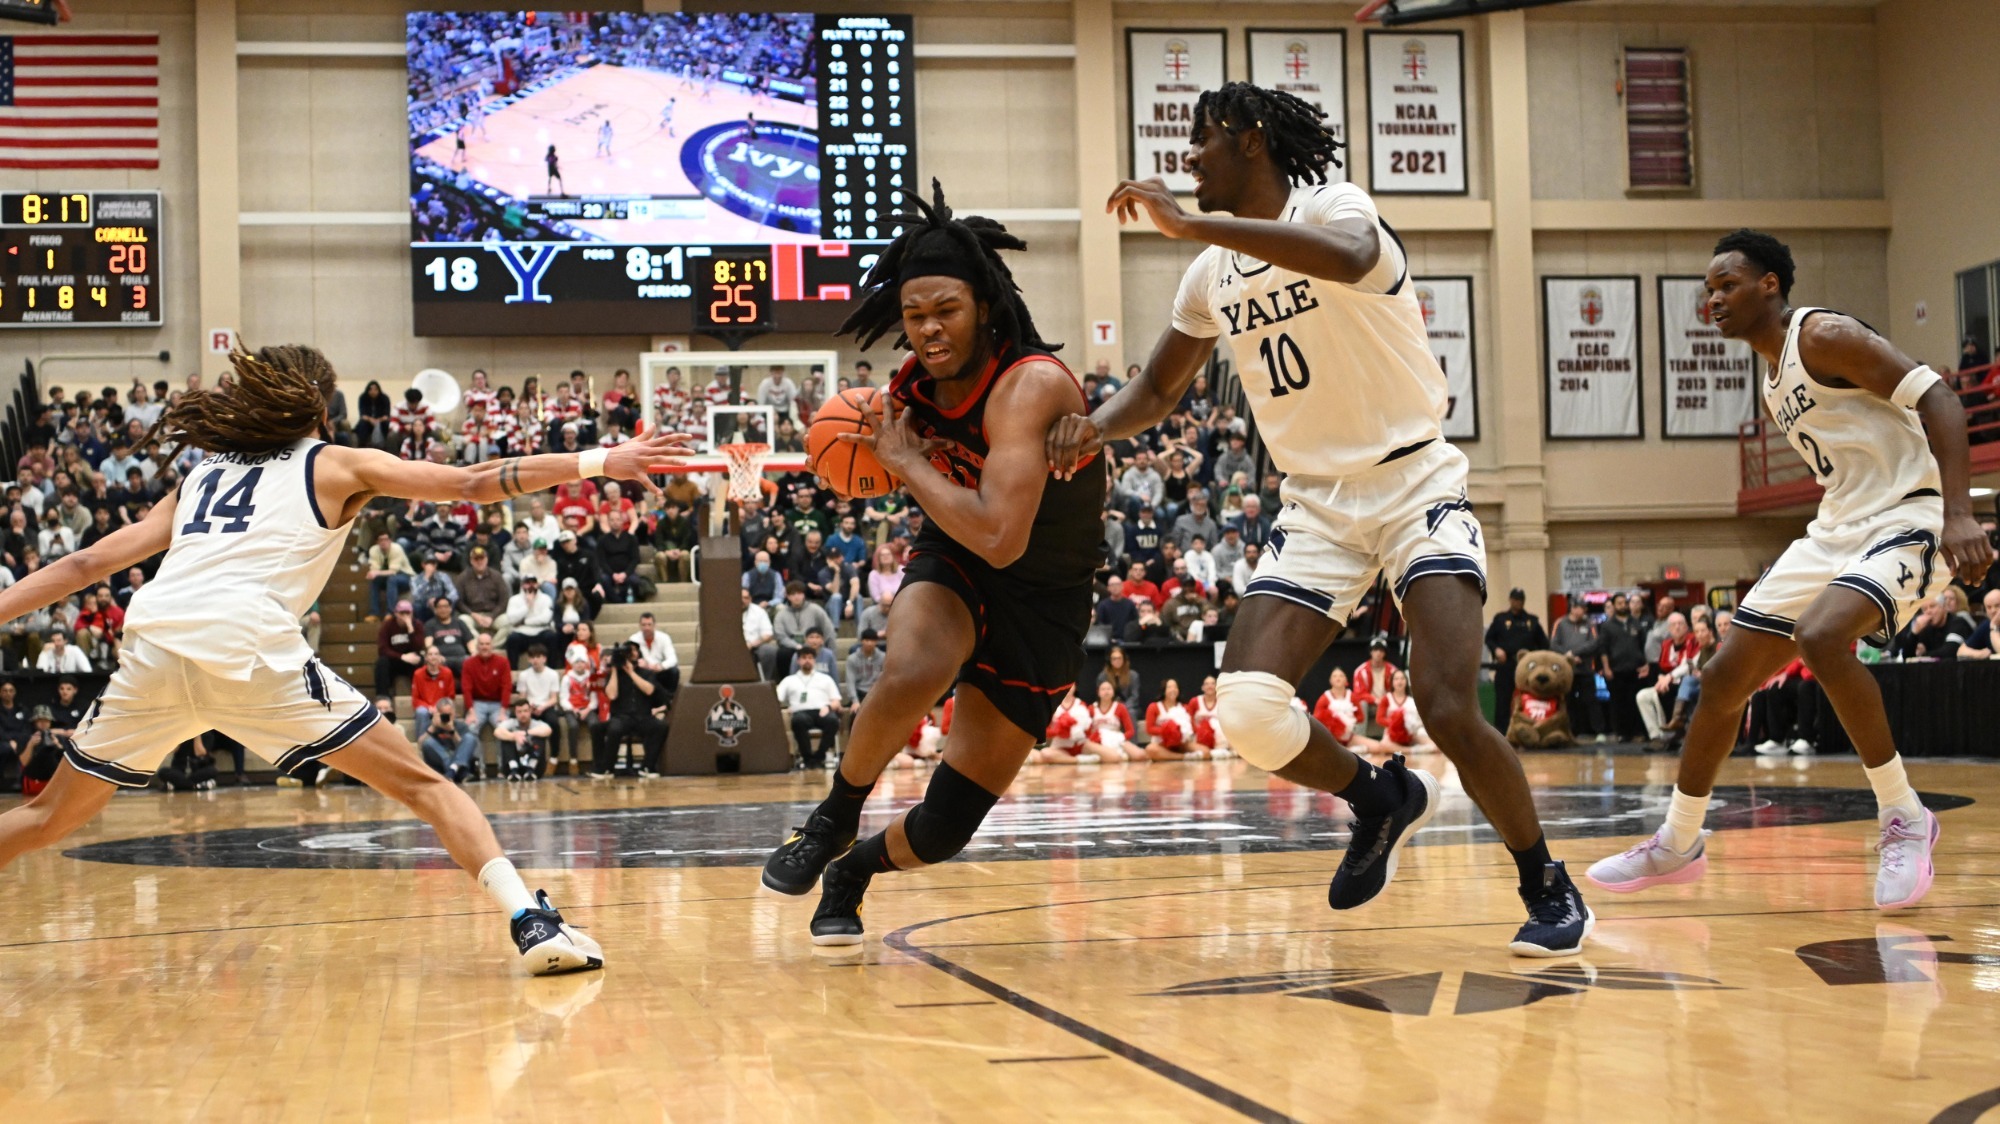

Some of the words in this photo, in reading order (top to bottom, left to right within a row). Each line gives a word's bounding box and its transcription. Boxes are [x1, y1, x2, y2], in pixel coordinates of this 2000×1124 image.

[862, 61, 872, 75] 1
[889, 95, 900, 109] 7
[889, 113, 901, 126] 2
[1153, 103, 1191, 121] NCA
[1396, 104, 1437, 120] NCAA
[1138, 125, 1192, 138] TOURNA
[1378, 123, 1456, 136] TOURNAMENT
[1153, 151, 1193, 174] 199
[1391, 150, 1446, 174] 2021
[866, 173, 876, 187] 1
[23, 194, 87, 224] 8:17
[29, 235, 63, 246] PERIOD
[95, 227, 148, 242] CORNELL
[46, 249, 54, 270] 1
[109, 244, 146, 273] 20
[17, 275, 40, 285] FOUL
[42, 275, 75, 285] PLAYER
[120, 275, 150, 285] FOULS
[425, 257, 479, 291] 18
[483, 244, 571, 304] Y
[714, 260, 767, 284] 8:17
[91, 287, 107, 307] 4
[132, 285, 146, 309] 3
[638, 285, 692, 298] PERIOD
[711, 284, 757, 323] 25
[1221, 279, 1319, 336] YALE
[22, 311, 74, 322] ADVANTAGE
[121, 311, 150, 322] SCORE
[213, 332, 229, 350] R
[1096, 324, 1111, 341] T
[1685, 330, 1722, 339] GYMNAST
[1577, 343, 1609, 356] ECAC
[1260, 333, 1310, 397] 10
[1558, 358, 1631, 372] CHAMPIONS
[1670, 359, 1698, 372] TEAM
[1701, 358, 1749, 372] FINALIST
[1560, 378, 1589, 391] 2014
[1678, 377, 1707, 391] 2013
[1676, 396, 1707, 410] 2022
[1776, 383, 1817, 436] YALE
[202, 447, 295, 467] SIMMONS
[1798, 431, 1834, 477] 2
[181, 466, 264, 536] 14
[1462, 519, 1479, 549] Y
[1896, 560, 1914, 590] Y
